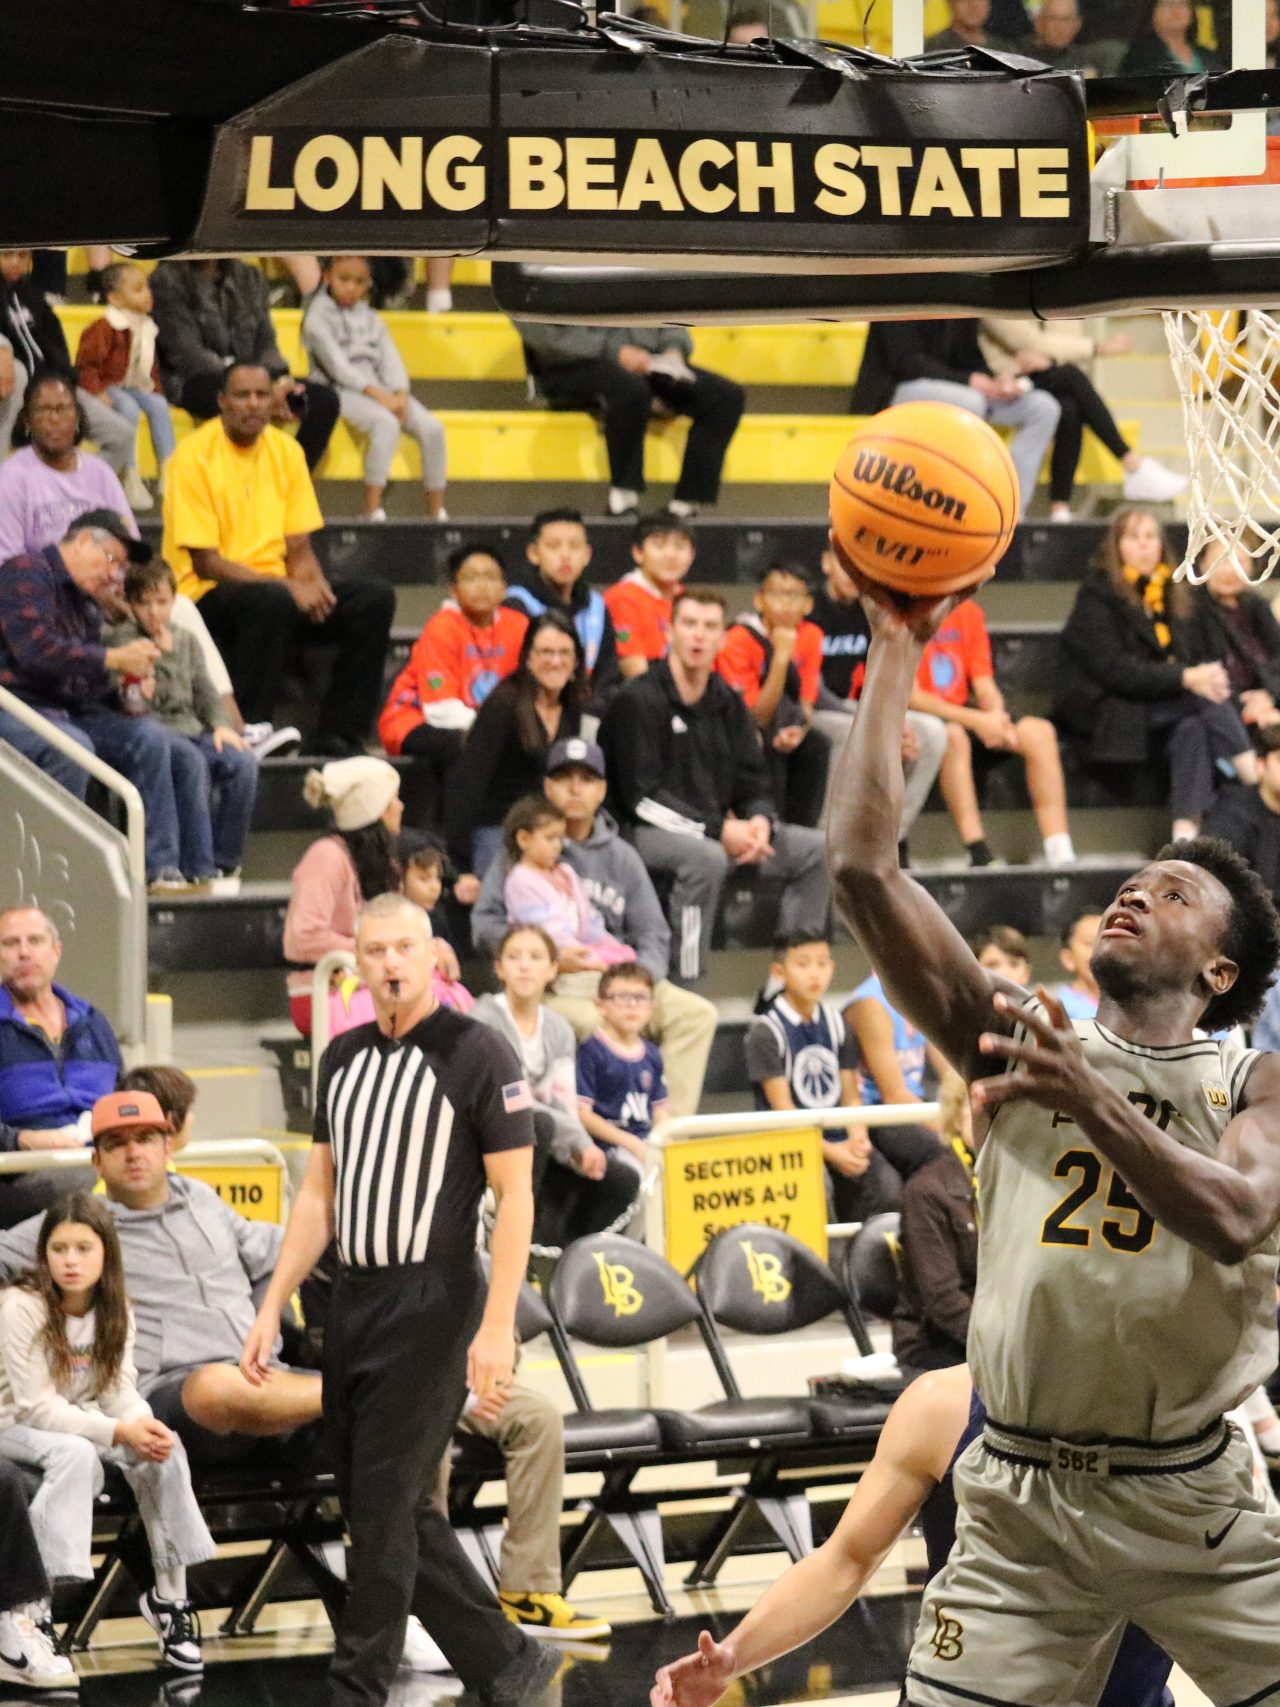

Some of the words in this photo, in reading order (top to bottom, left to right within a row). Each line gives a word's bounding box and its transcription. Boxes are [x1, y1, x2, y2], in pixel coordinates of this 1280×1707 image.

[246, 135, 485, 212] LONG
[509, 136, 795, 214] BEACH
[814, 144, 1070, 219] STATE
[853, 447, 967, 522] Wilson
[684, 1155, 773, 1182] SECTION
[779, 1151, 804, 1169] 111
[229, 1184, 263, 1204] 110
[693, 1187, 755, 1212] ROWS
[762, 1183, 798, 1203] A-U
[1041, 1148, 1157, 1253] 25
[1057, 1448, 1099, 1474] 562
